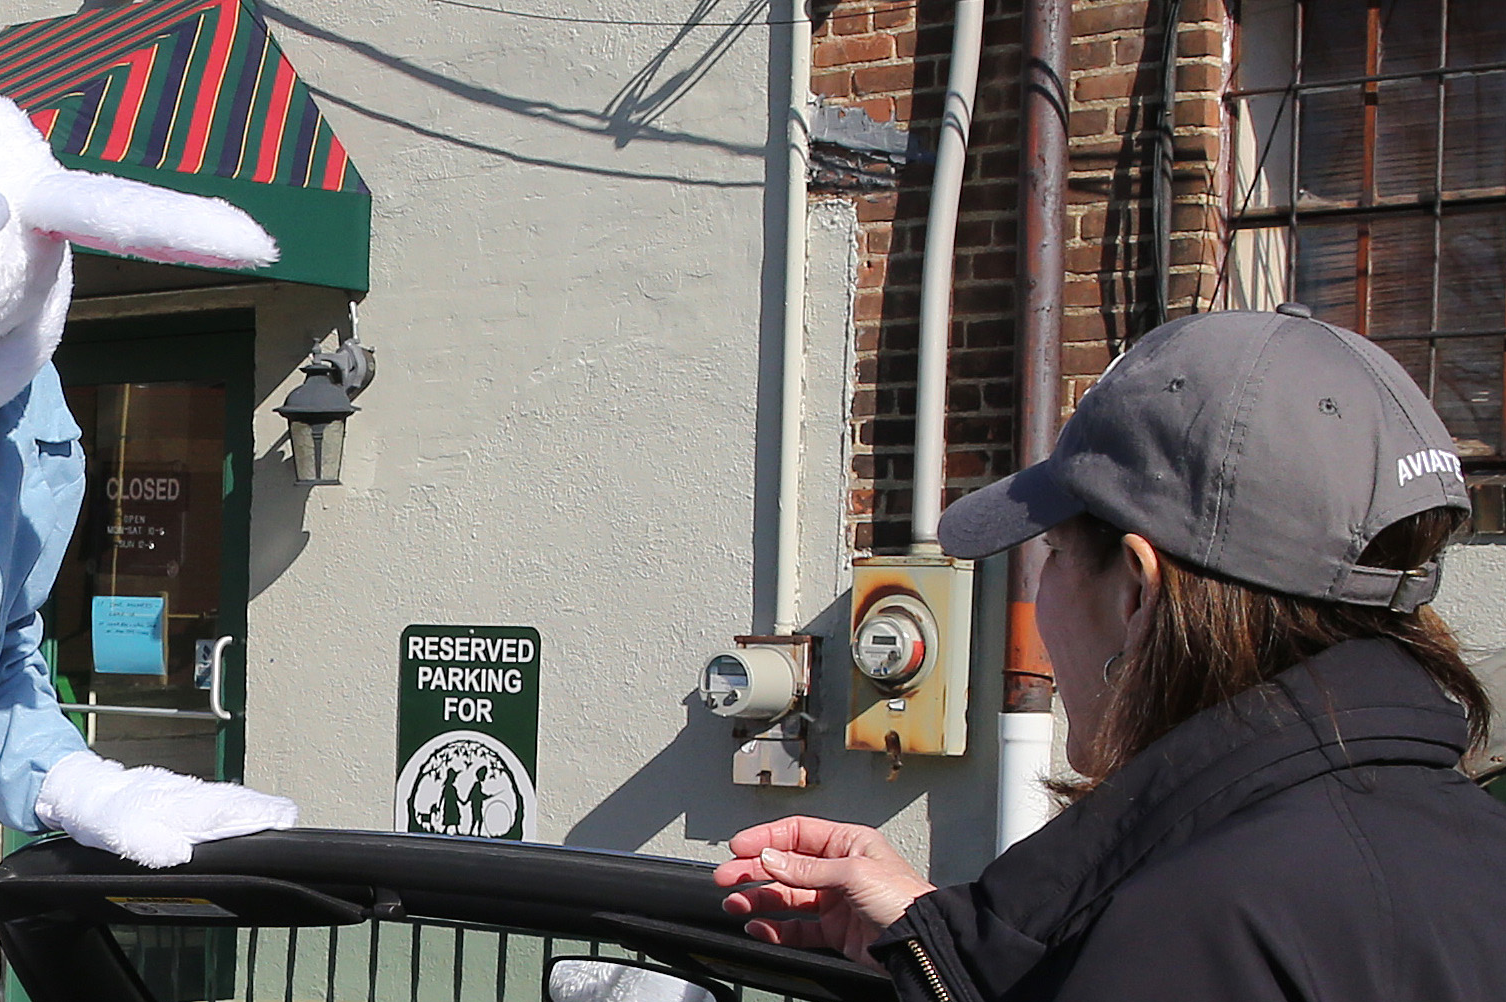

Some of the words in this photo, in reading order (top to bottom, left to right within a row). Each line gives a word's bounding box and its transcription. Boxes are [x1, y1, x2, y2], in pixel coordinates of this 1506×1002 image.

[106, 477, 180, 500] CLOSED
[408, 636, 535, 663] RESERVED
[417, 667, 523, 694] PARKING
[444, 697, 494, 723] FOR
